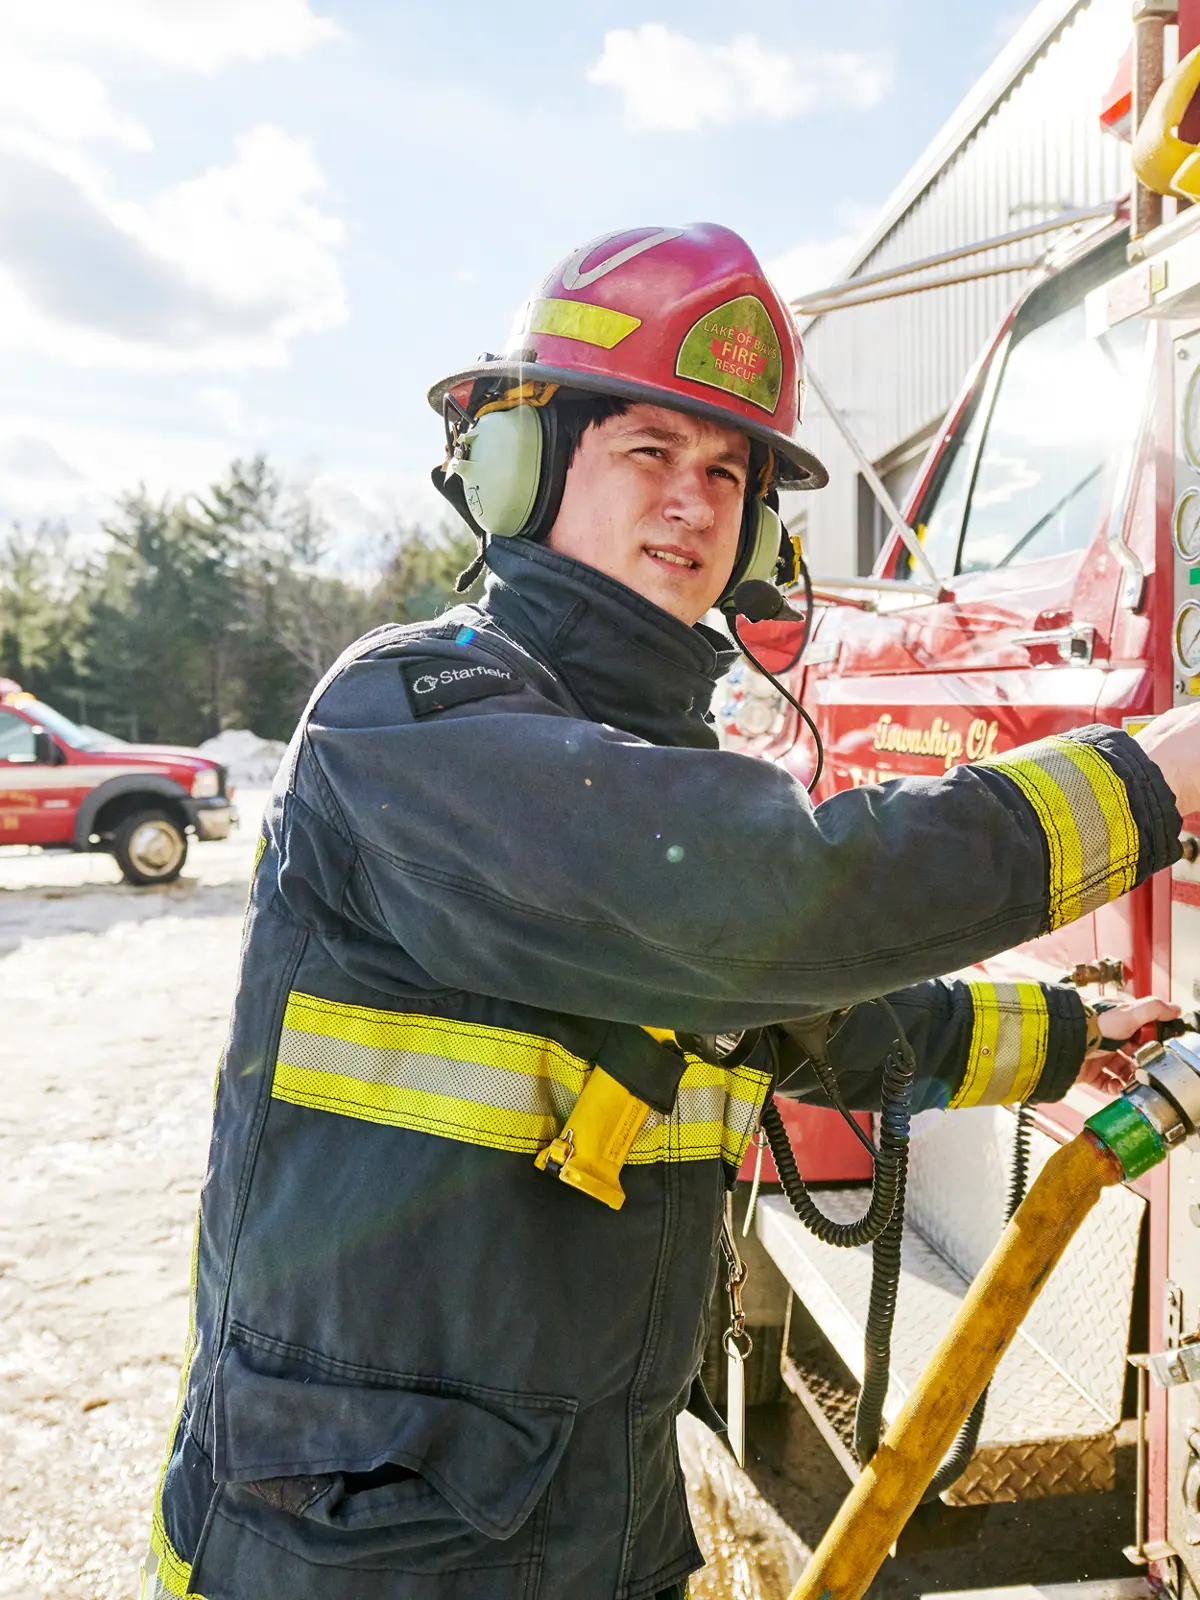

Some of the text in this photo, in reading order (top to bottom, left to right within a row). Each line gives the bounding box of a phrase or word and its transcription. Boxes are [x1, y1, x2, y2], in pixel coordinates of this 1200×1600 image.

[703, 321, 777, 359] LAKE OF BAYS
[721, 341, 758, 369] FIRE
[714, 358, 757, 383] RESCUE
[874, 713, 963, 769] Township
